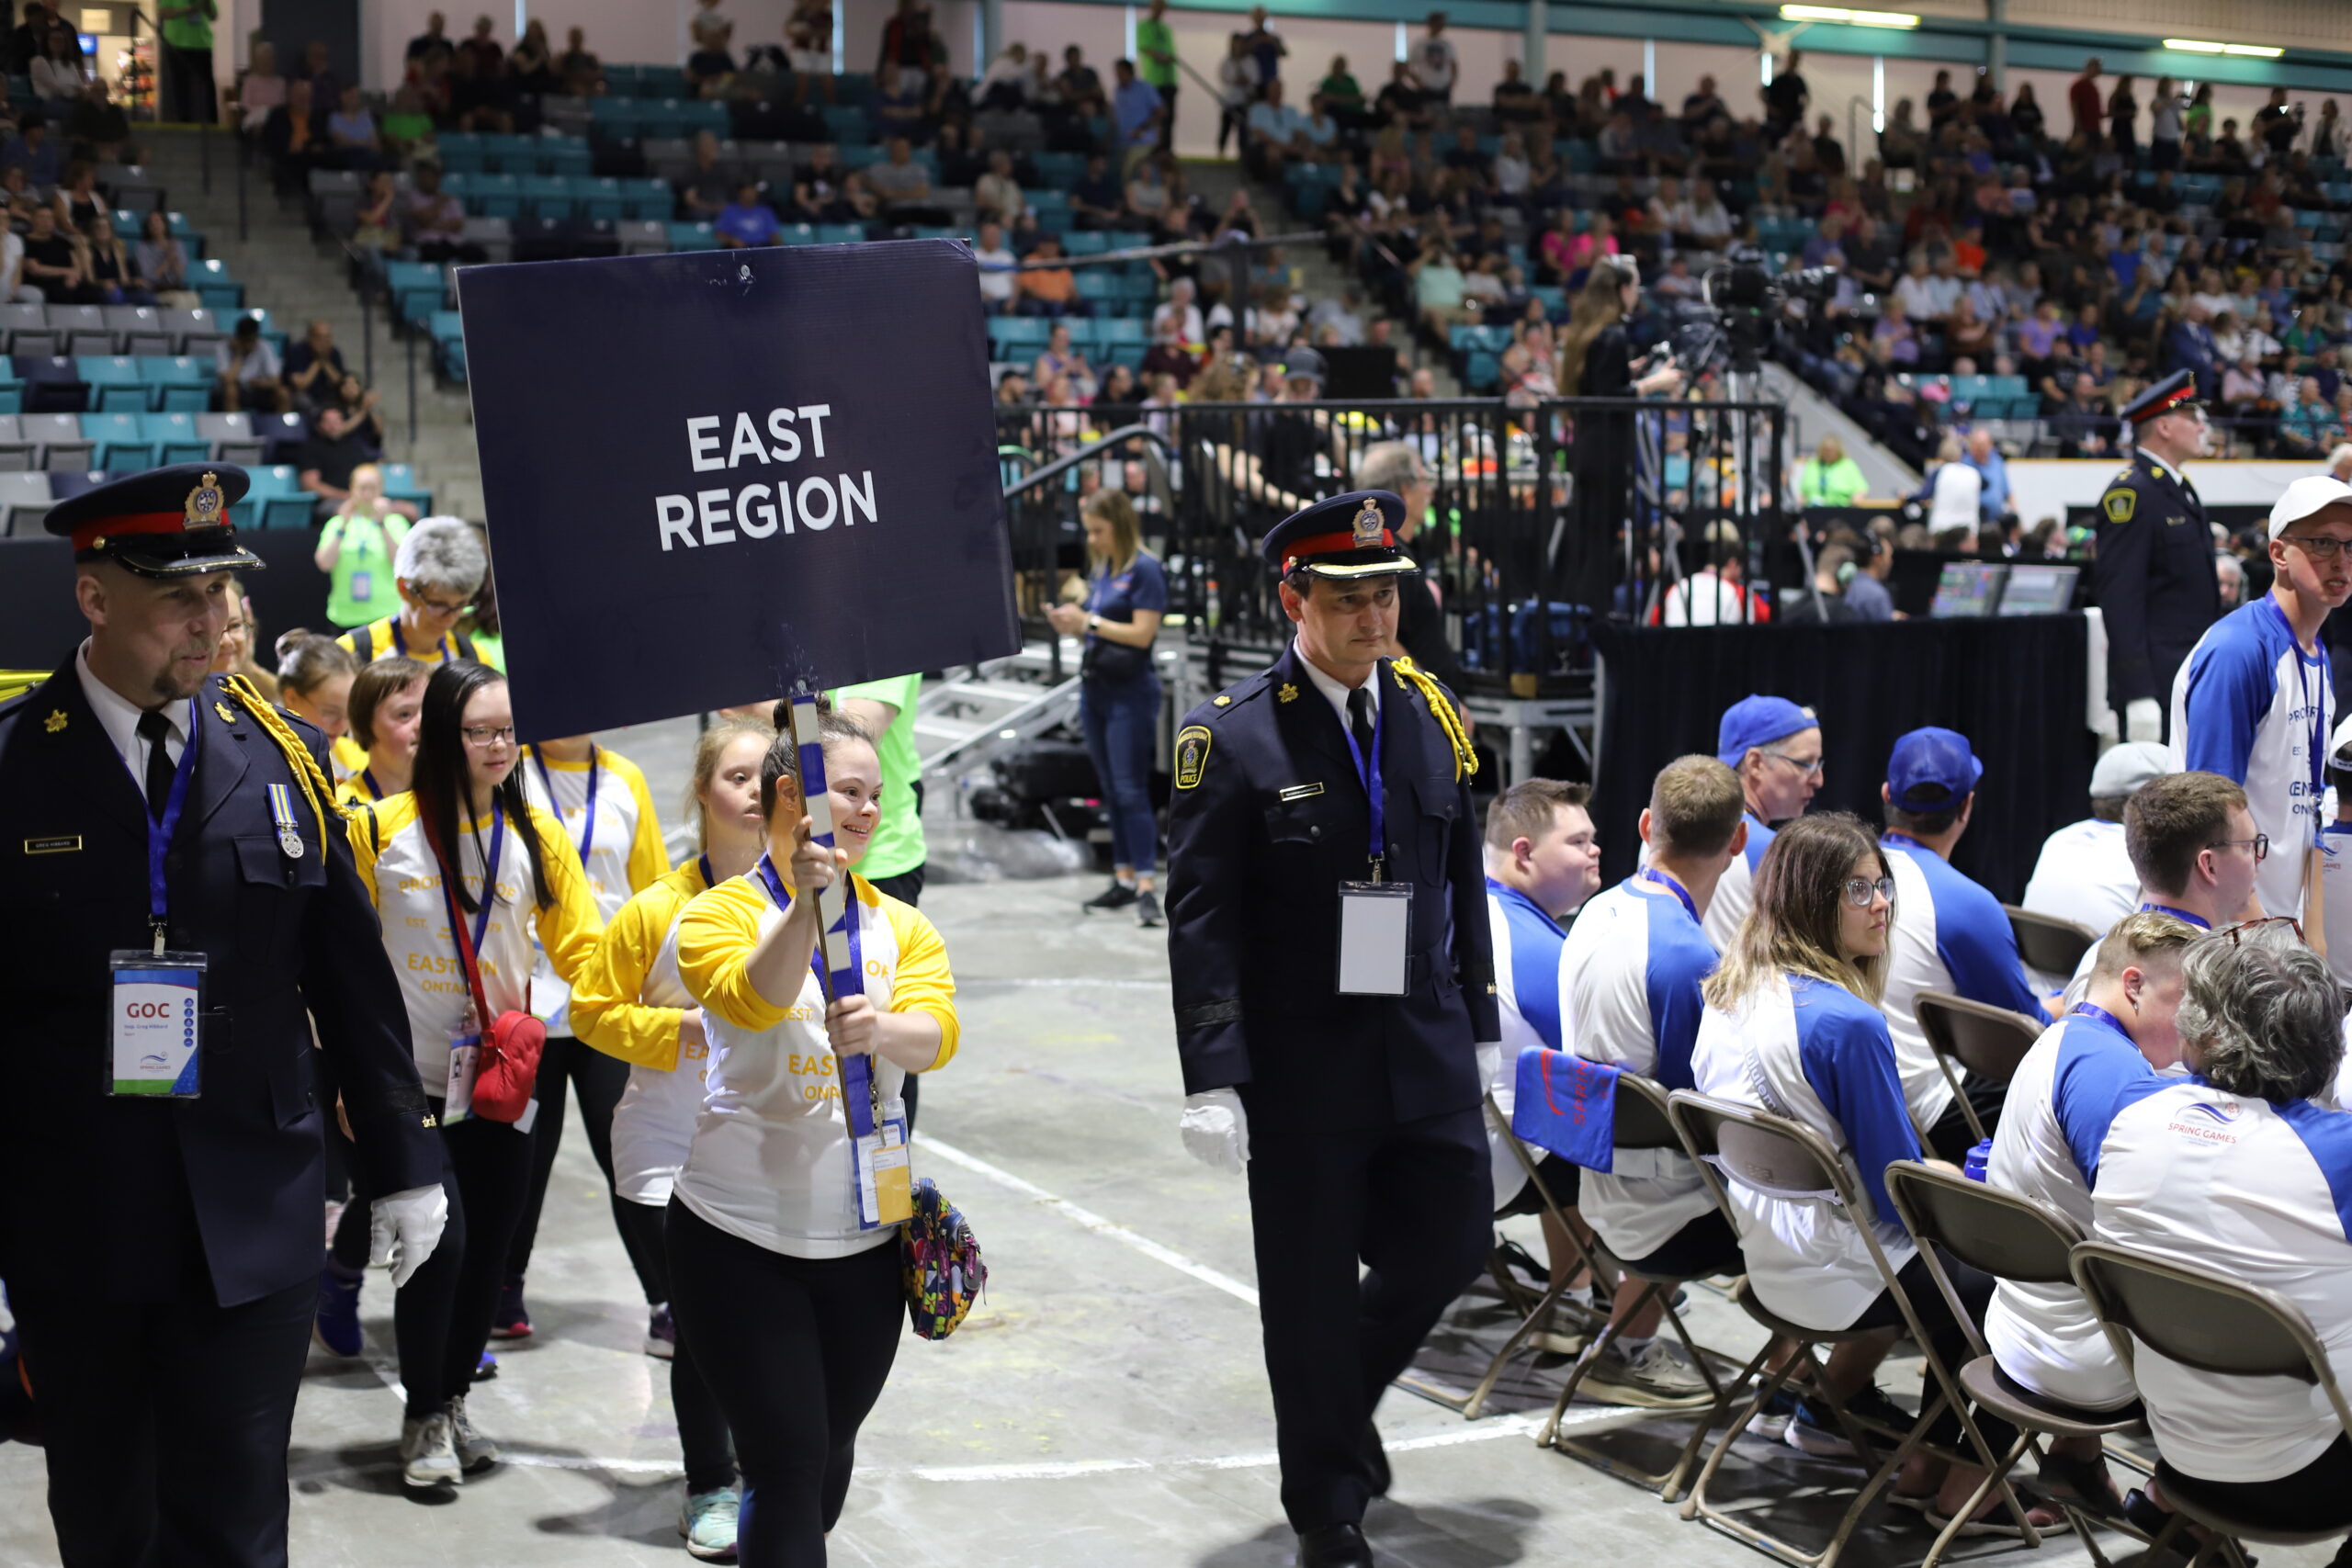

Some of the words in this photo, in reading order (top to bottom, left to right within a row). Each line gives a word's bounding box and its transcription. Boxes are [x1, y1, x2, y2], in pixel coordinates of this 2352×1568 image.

[686, 403, 831, 473] EAST
[655, 469, 878, 552] REGION
[1180, 773, 1198, 784] POLICE
[407, 952, 498, 976] EASTRN
[126, 1002, 170, 1019] GOC
[2167, 1122, 2202, 1137] SPRING
[2202, 1130, 2237, 1145] GAMES
